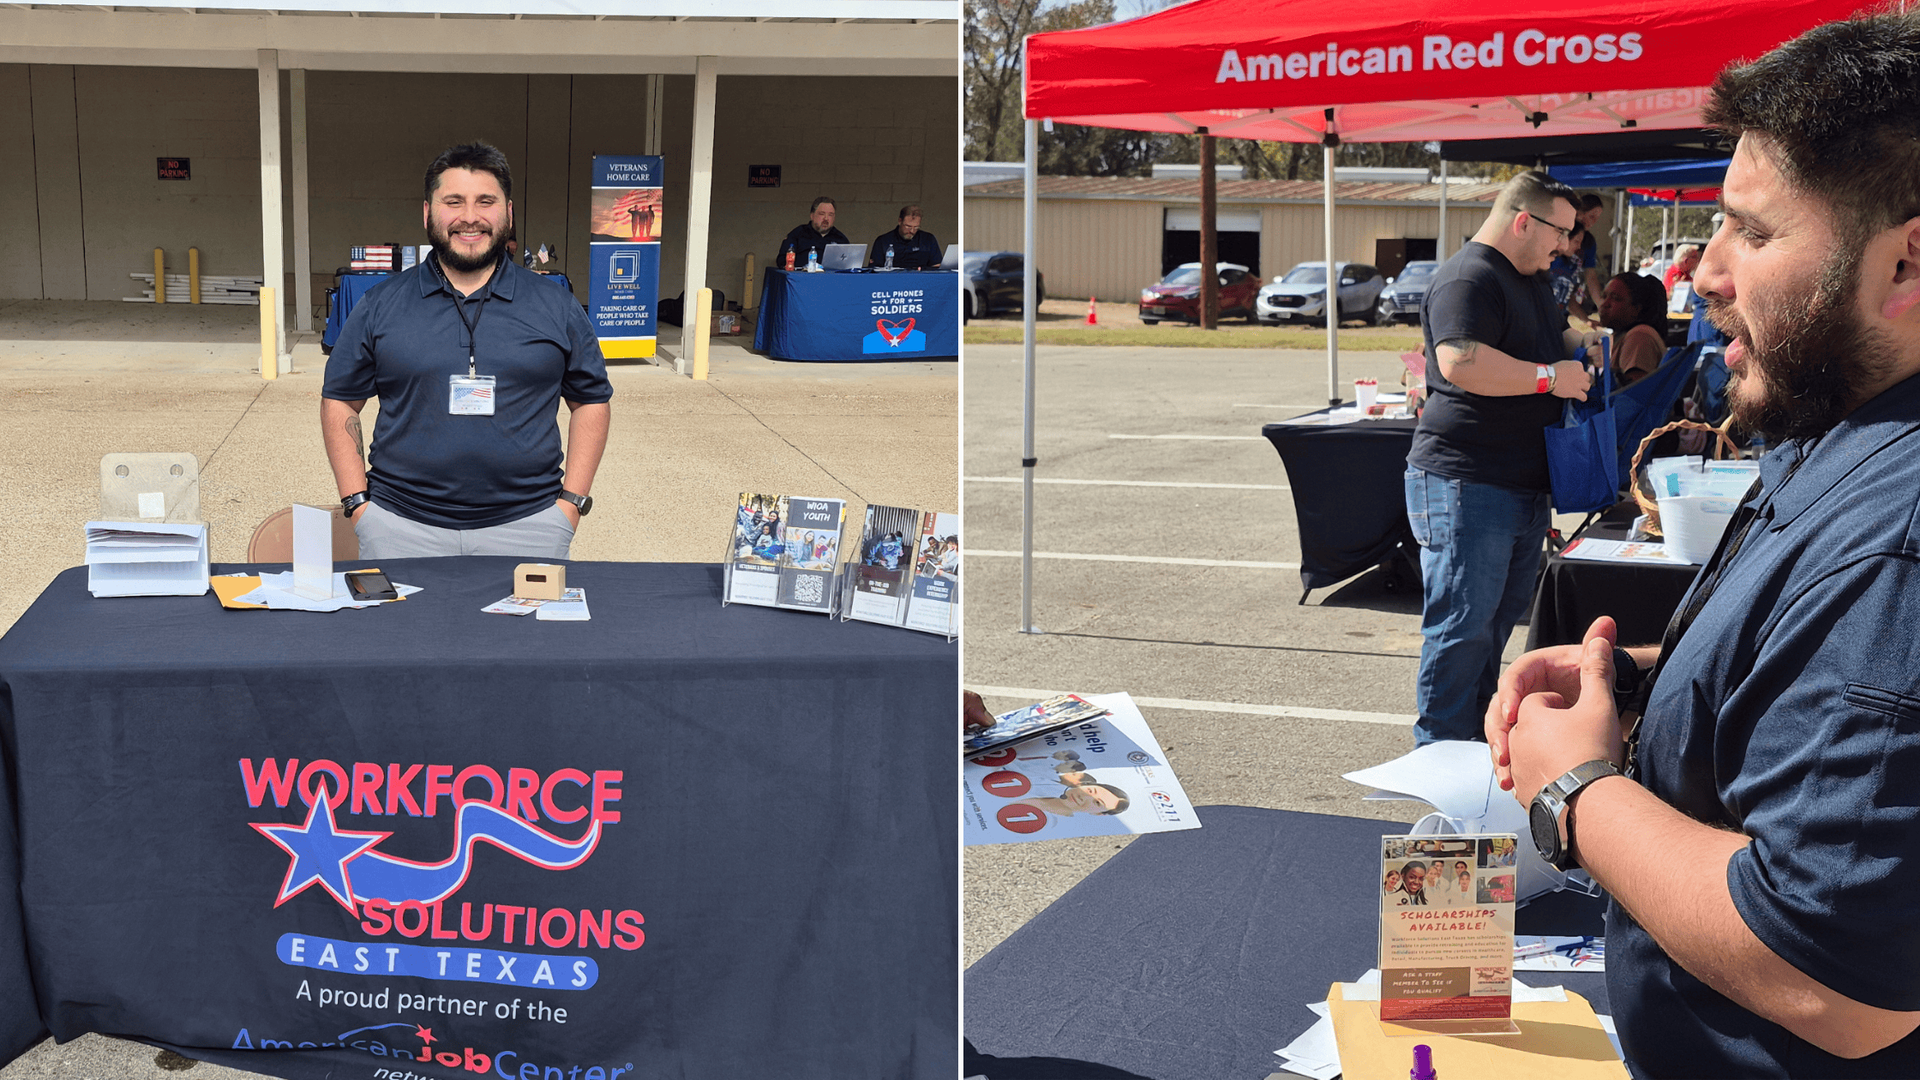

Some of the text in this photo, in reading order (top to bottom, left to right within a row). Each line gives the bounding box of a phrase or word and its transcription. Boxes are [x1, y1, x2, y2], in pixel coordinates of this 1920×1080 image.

[1215, 28, 1644, 84] American Red Cross
[167, 160, 179, 168] NO
[609, 163, 648, 171] VETERANS
[160, 169, 188, 178] PARKING
[606, 173, 650, 181] HOME CARE
[760, 168, 771, 176] NO
[751, 176, 779, 185] PARKING
[892, 290, 924, 298] PHONES
[889, 297, 906, 305] FOR
[871, 304, 923, 315] SOLDIERS
[635, 311, 649, 319] TAKE
[806, 501, 829, 511] WIOA
[803, 512, 831, 521] YOUTH
[1083, 730, 1108, 753] help
[990, 778, 1023, 789] 1
[239, 757, 624, 824] WORKFORCE
[1006, 812, 1039, 823] 1
[1400, 909, 1497, 920] SCHOLARSHIPS
[360, 897, 646, 951] SOLUTIONS
[1409, 921, 1487, 932] AVAILABLE!
[290, 937, 589, 988] EAST TEXAS
[296, 979, 568, 1024] A proud partner of the
